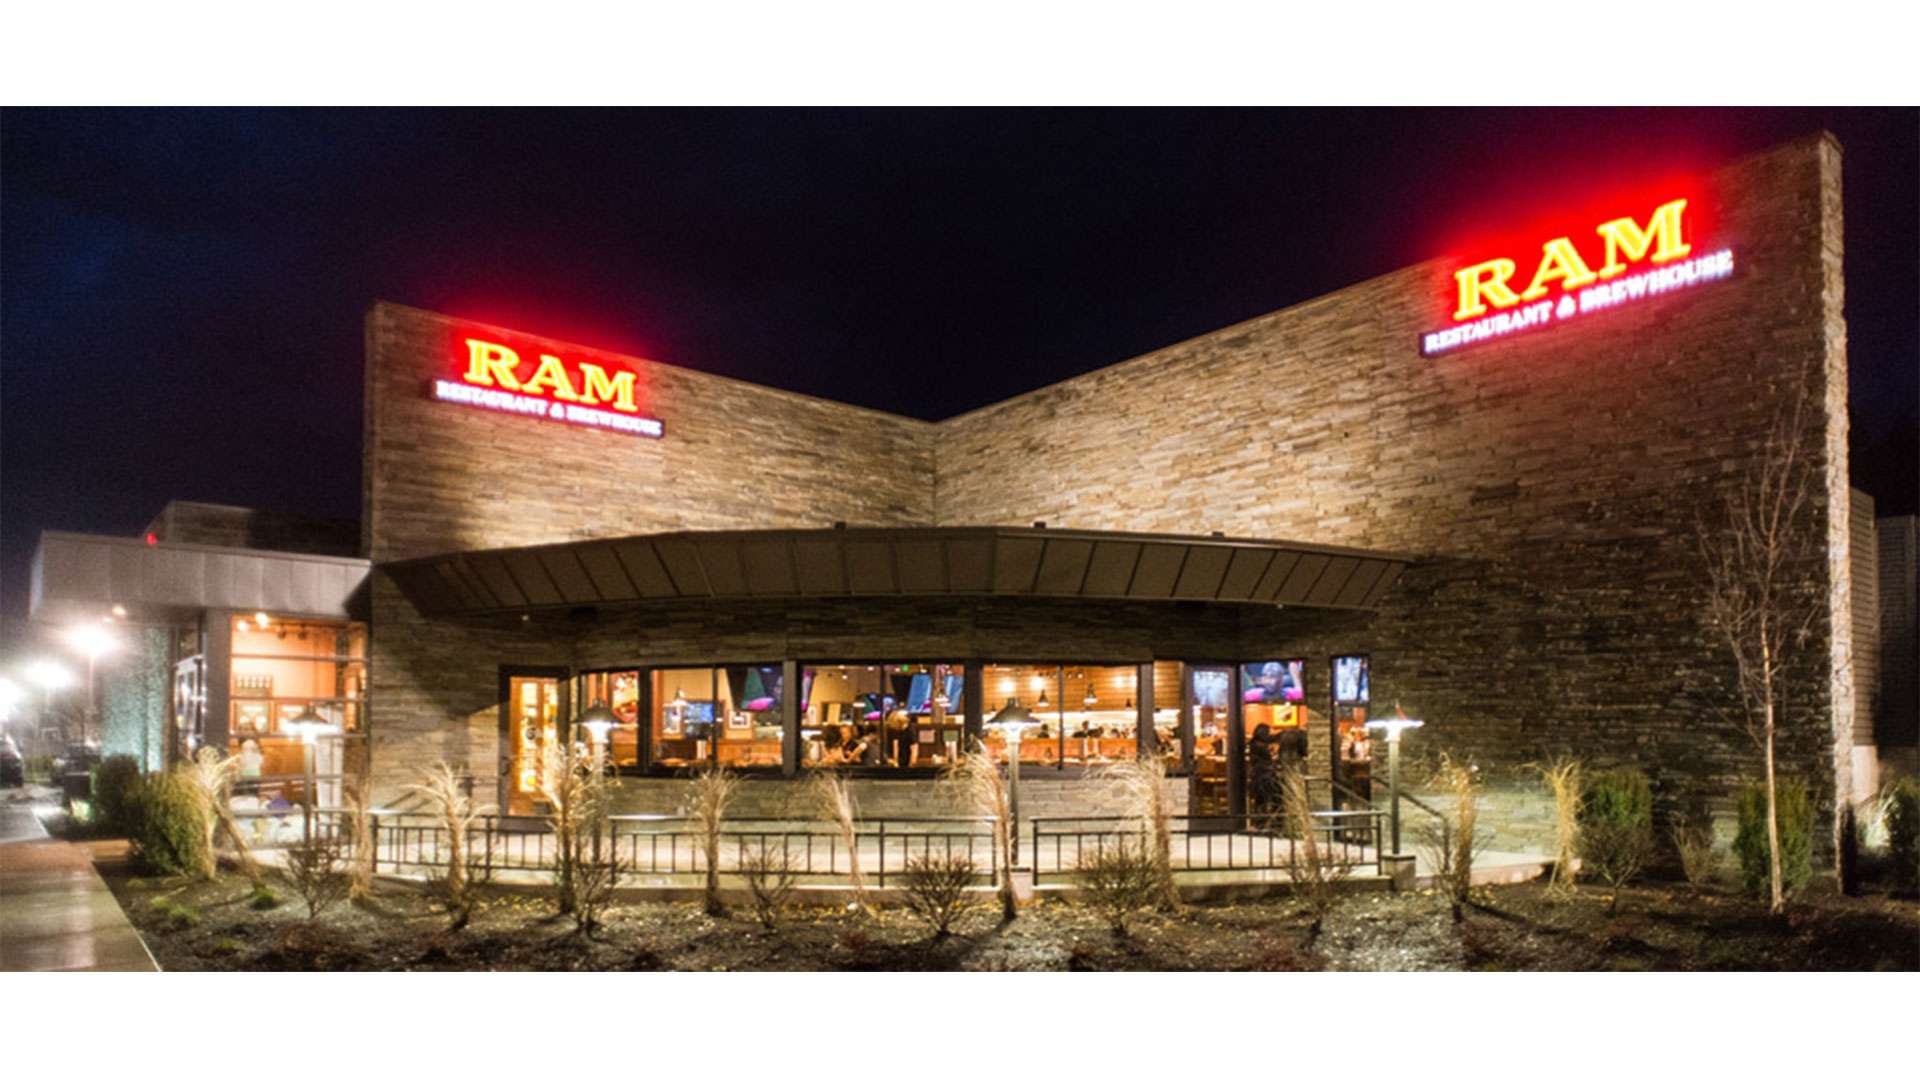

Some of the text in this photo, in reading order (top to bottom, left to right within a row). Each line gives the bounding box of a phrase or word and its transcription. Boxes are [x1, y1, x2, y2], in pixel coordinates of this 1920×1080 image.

[1424, 249, 1734, 354] RESTAURANT & BREWHOUSE
[1453, 199, 1691, 320] RAM
[436, 380, 547, 415] RESTAURANT
[549, 402, 565, 419] &
[464, 339, 638, 412] RAM
